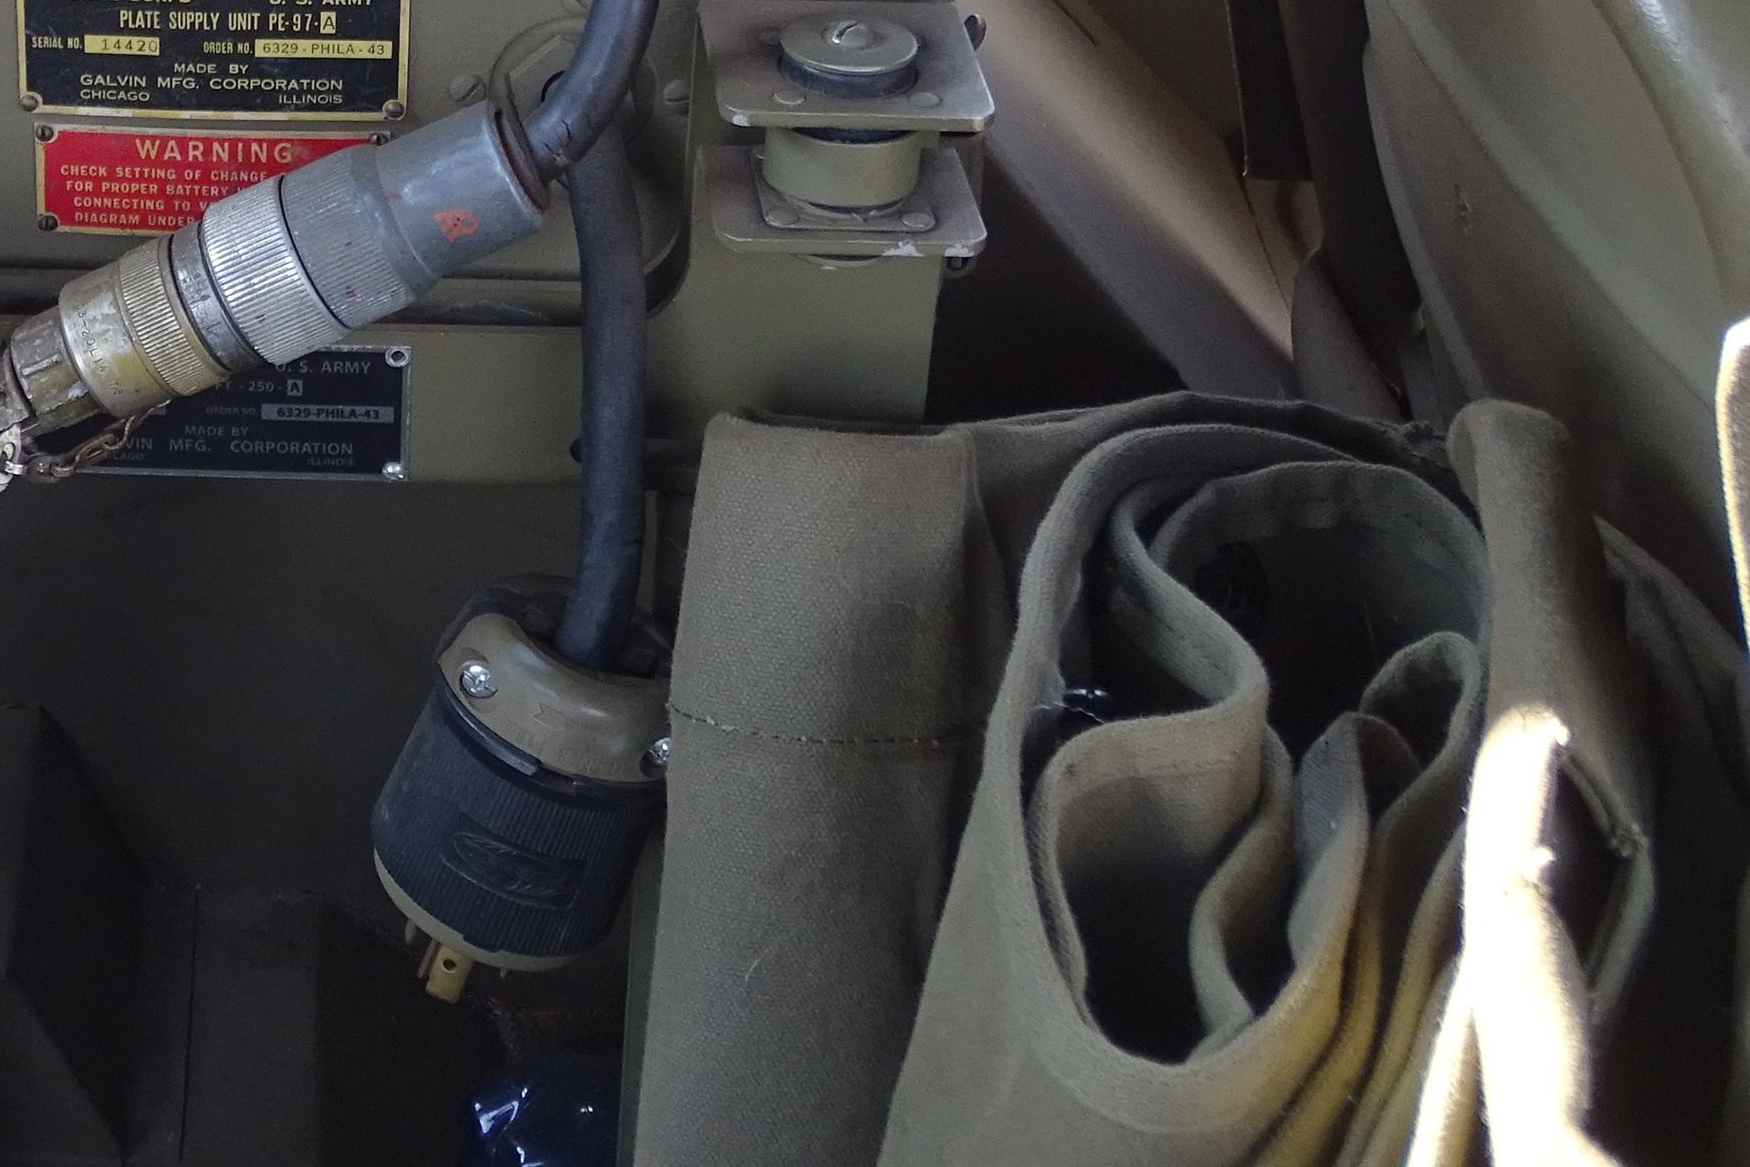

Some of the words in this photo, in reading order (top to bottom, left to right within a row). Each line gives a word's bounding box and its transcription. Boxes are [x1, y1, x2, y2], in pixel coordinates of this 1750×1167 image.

[119, 10, 161, 30] PLATE
[169, 11, 220, 31] SUPPLY
[228, 12, 261, 31] UNIT
[31, 36, 63, 49] SERIAL
[67, 37, 83, 50] NO.
[101, 38, 158, 53] 14420
[203, 41, 234, 54] ORDER
[237, 42, 253, 55] NO.
[174, 63, 217, 74] MADE
[229, 64, 249, 75] BY
[80, 74, 147, 88] GALVIN
[157, 77, 199, 90] MFG.
[209, 78, 343, 91] CORPORATION
[80, 89, 151, 102] CHICAGO
[278, 94, 344, 105] ILLINOIS
[135, 138, 294, 165] WARNING
[60, 164, 107, 177] CHECK
[116, 166, 176, 180] SETTING
[184, 170, 202, 181] OF
[210, 170, 268, 183] CHANGE
[66, 180, 93, 192] FOR
[101, 182, 158, 195] PROPER
[165, 185, 229, 198] BATTERY
[73, 196, 165, 211] CONNECTING
[174, 200, 191, 212] TO
[75, 212, 140, 226] DIAGRAM
[321, 361, 372, 375] ARMY
[185, 425, 224, 437] MADE
[231, 426, 249, 437] BY
[169, 439, 212, 452] MFG.
[230, 440, 354, 455] CORPORATION
[307, 458, 355, 468] ILLINOIS
